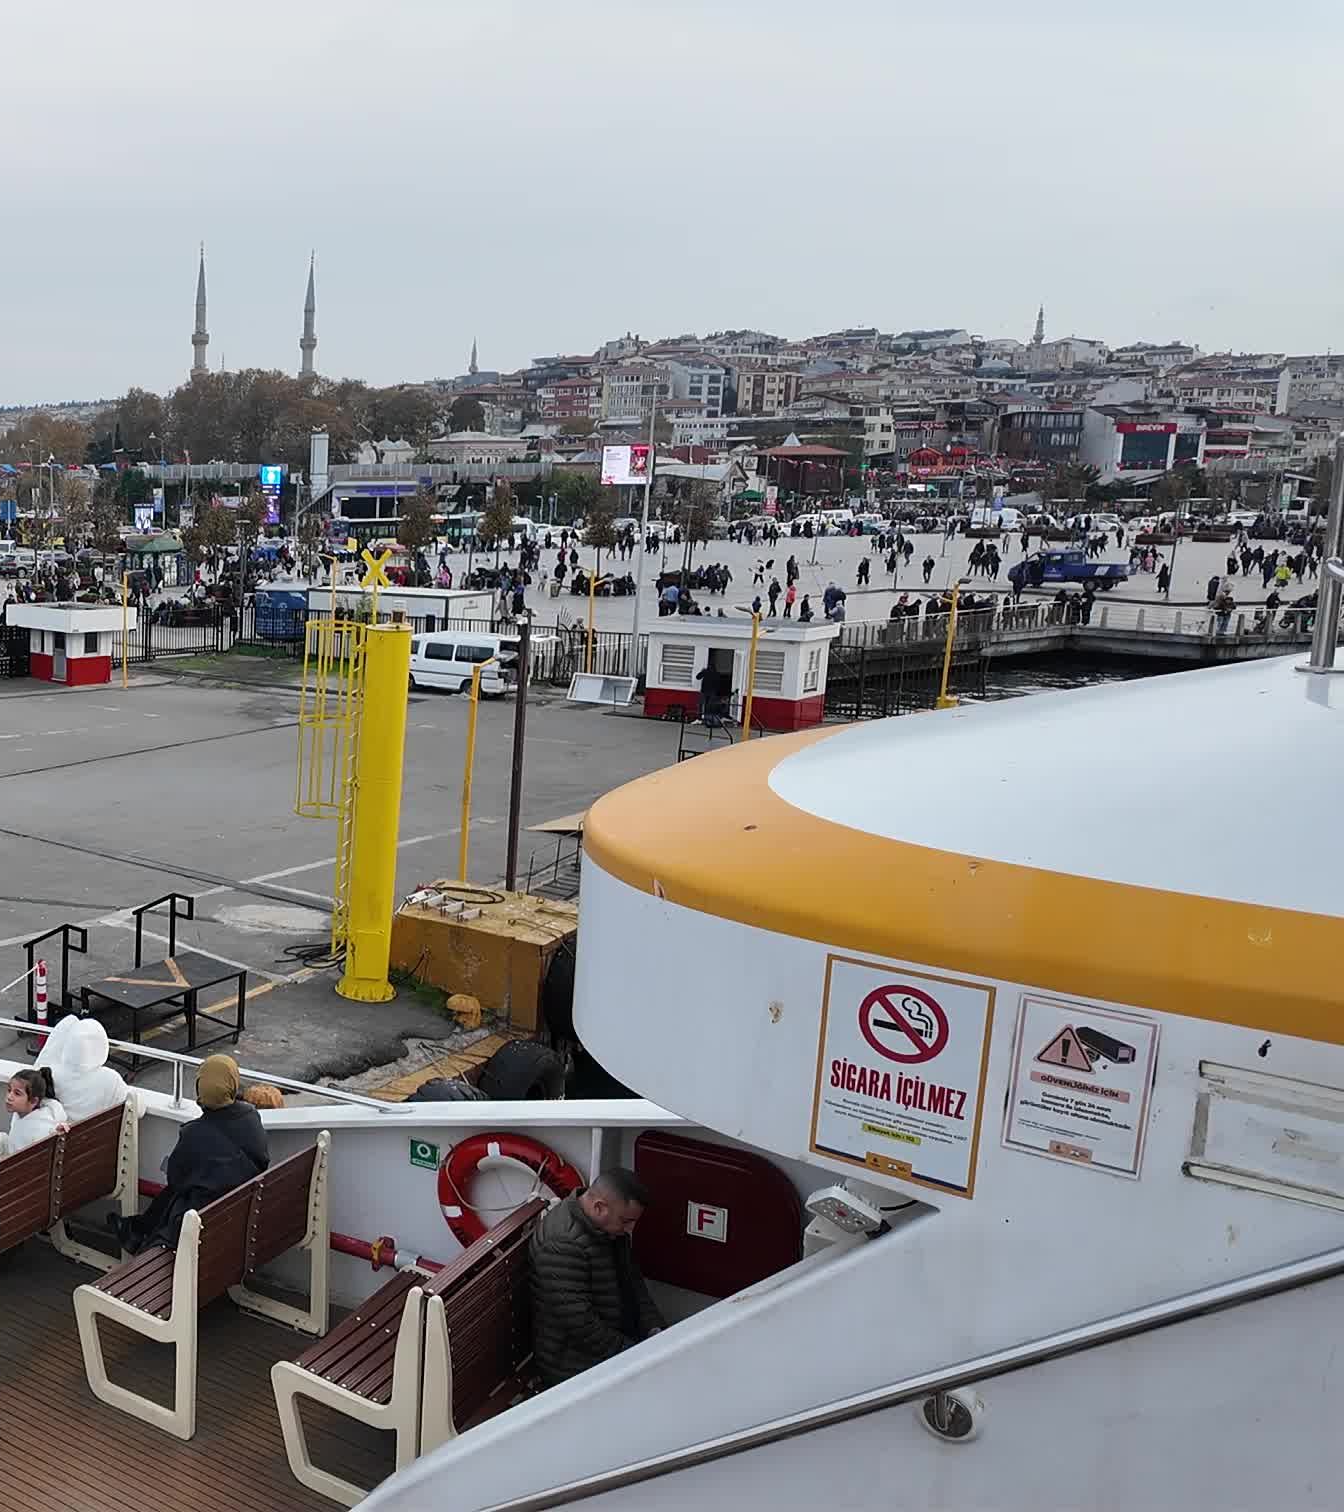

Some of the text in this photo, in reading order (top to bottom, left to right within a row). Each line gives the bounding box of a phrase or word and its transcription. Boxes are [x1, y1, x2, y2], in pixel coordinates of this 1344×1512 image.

[830, 1057, 891, 1101] SİGARA
[895, 1071, 967, 1121] İÇİLMEZ
[697, 1208, 716, 1231] F
